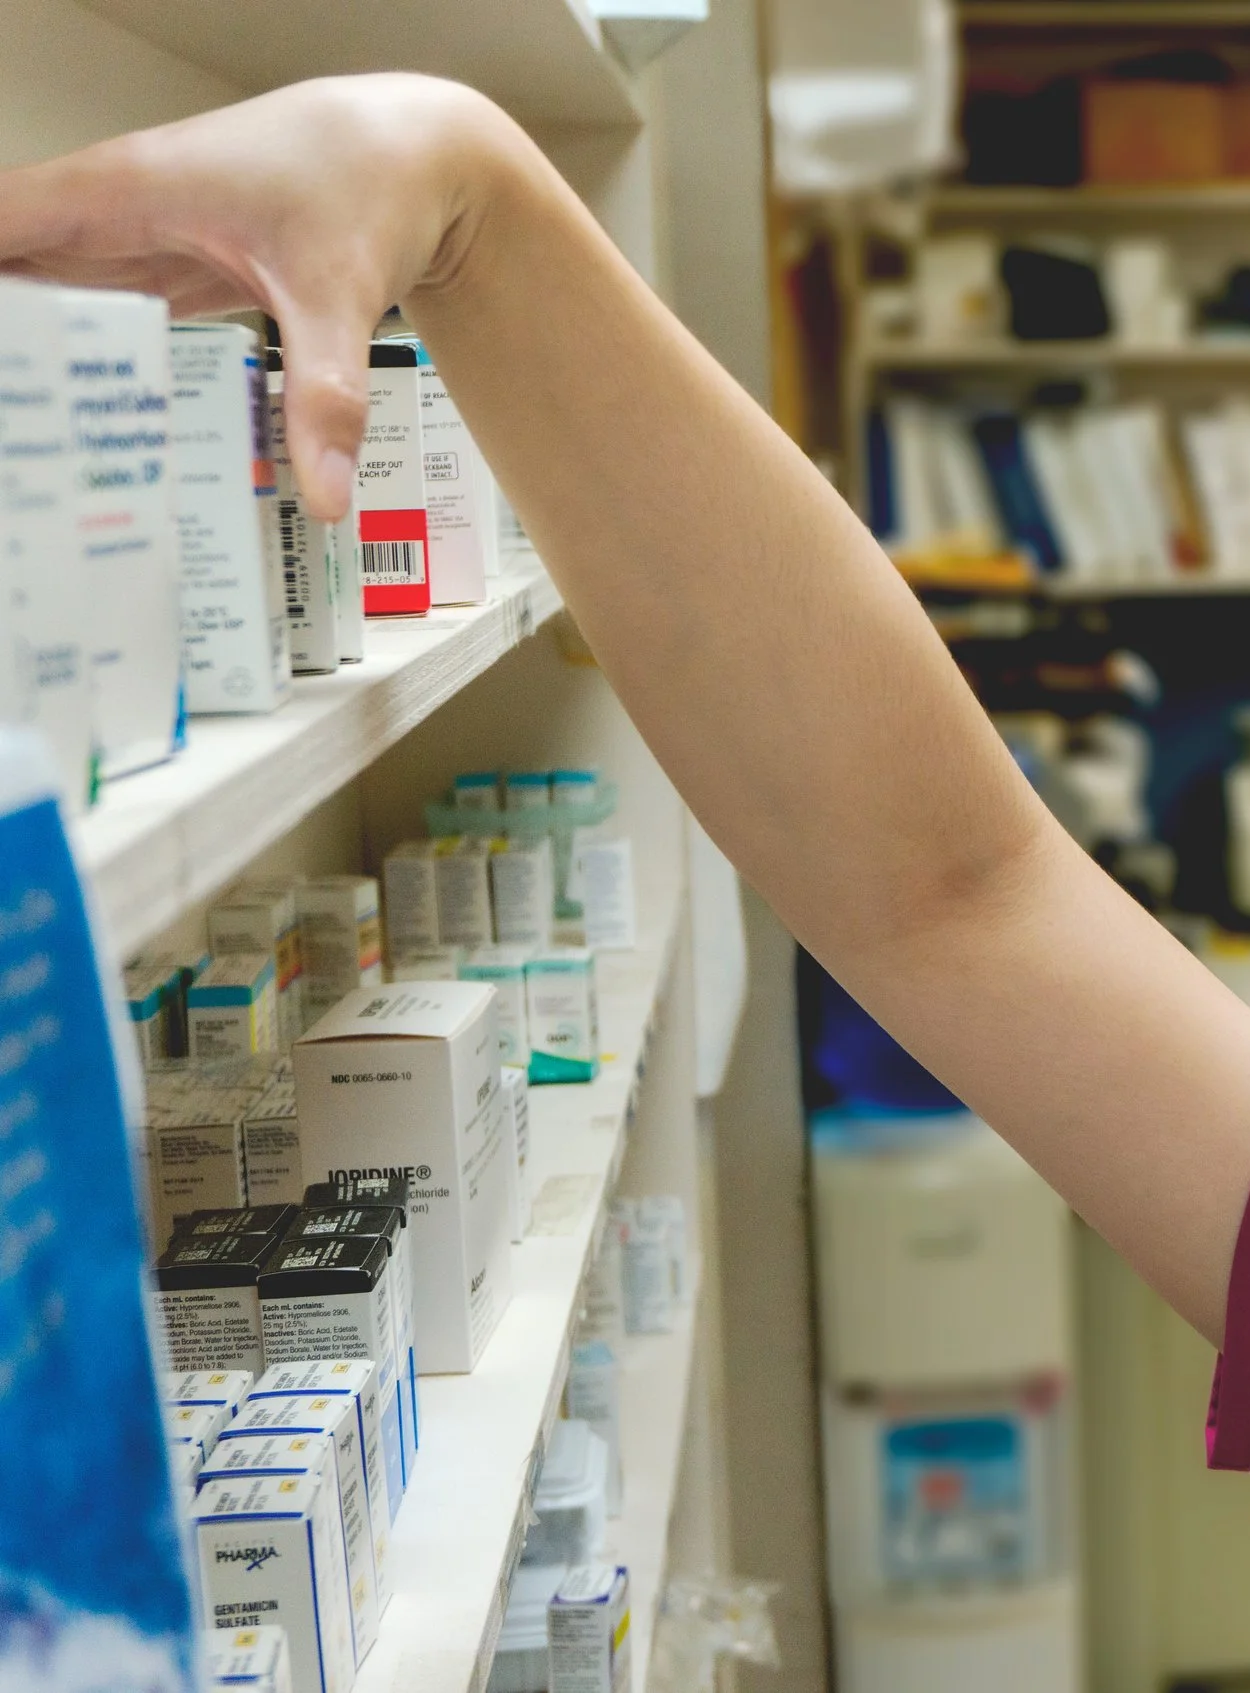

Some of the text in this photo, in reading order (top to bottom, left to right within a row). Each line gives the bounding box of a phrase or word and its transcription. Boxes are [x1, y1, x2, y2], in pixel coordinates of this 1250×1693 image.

[363, 435, 382, 444] ightly
[331, 1072, 412, 1084] NDC 0065-0660-10
[409, 1188, 449, 1199] chloride
[184, 1294, 216, 1302] contains:
[179, 1302, 222, 1311] Hypromellose
[262, 1303, 279, 1311] Each
[293, 1302, 324, 1310] contains:
[263, 1312, 286, 1320] Active:
[288, 1310, 330, 1319] Hypromellose
[225, 1318, 249, 1326] Edetate
[189, 1328, 222, 1336] Potassium
[298, 1328, 314, 1336] Boric
[297, 1336, 330, 1344] Potassium
[213, 1344, 233, 1352] and/or
[265, 1347, 288, 1355] Sodium
[266, 1355, 305, 1364] Hydrochloric
[214, 1600, 279, 1616] GENTAMICIN
[215, 1615, 261, 1629] SULFATE
